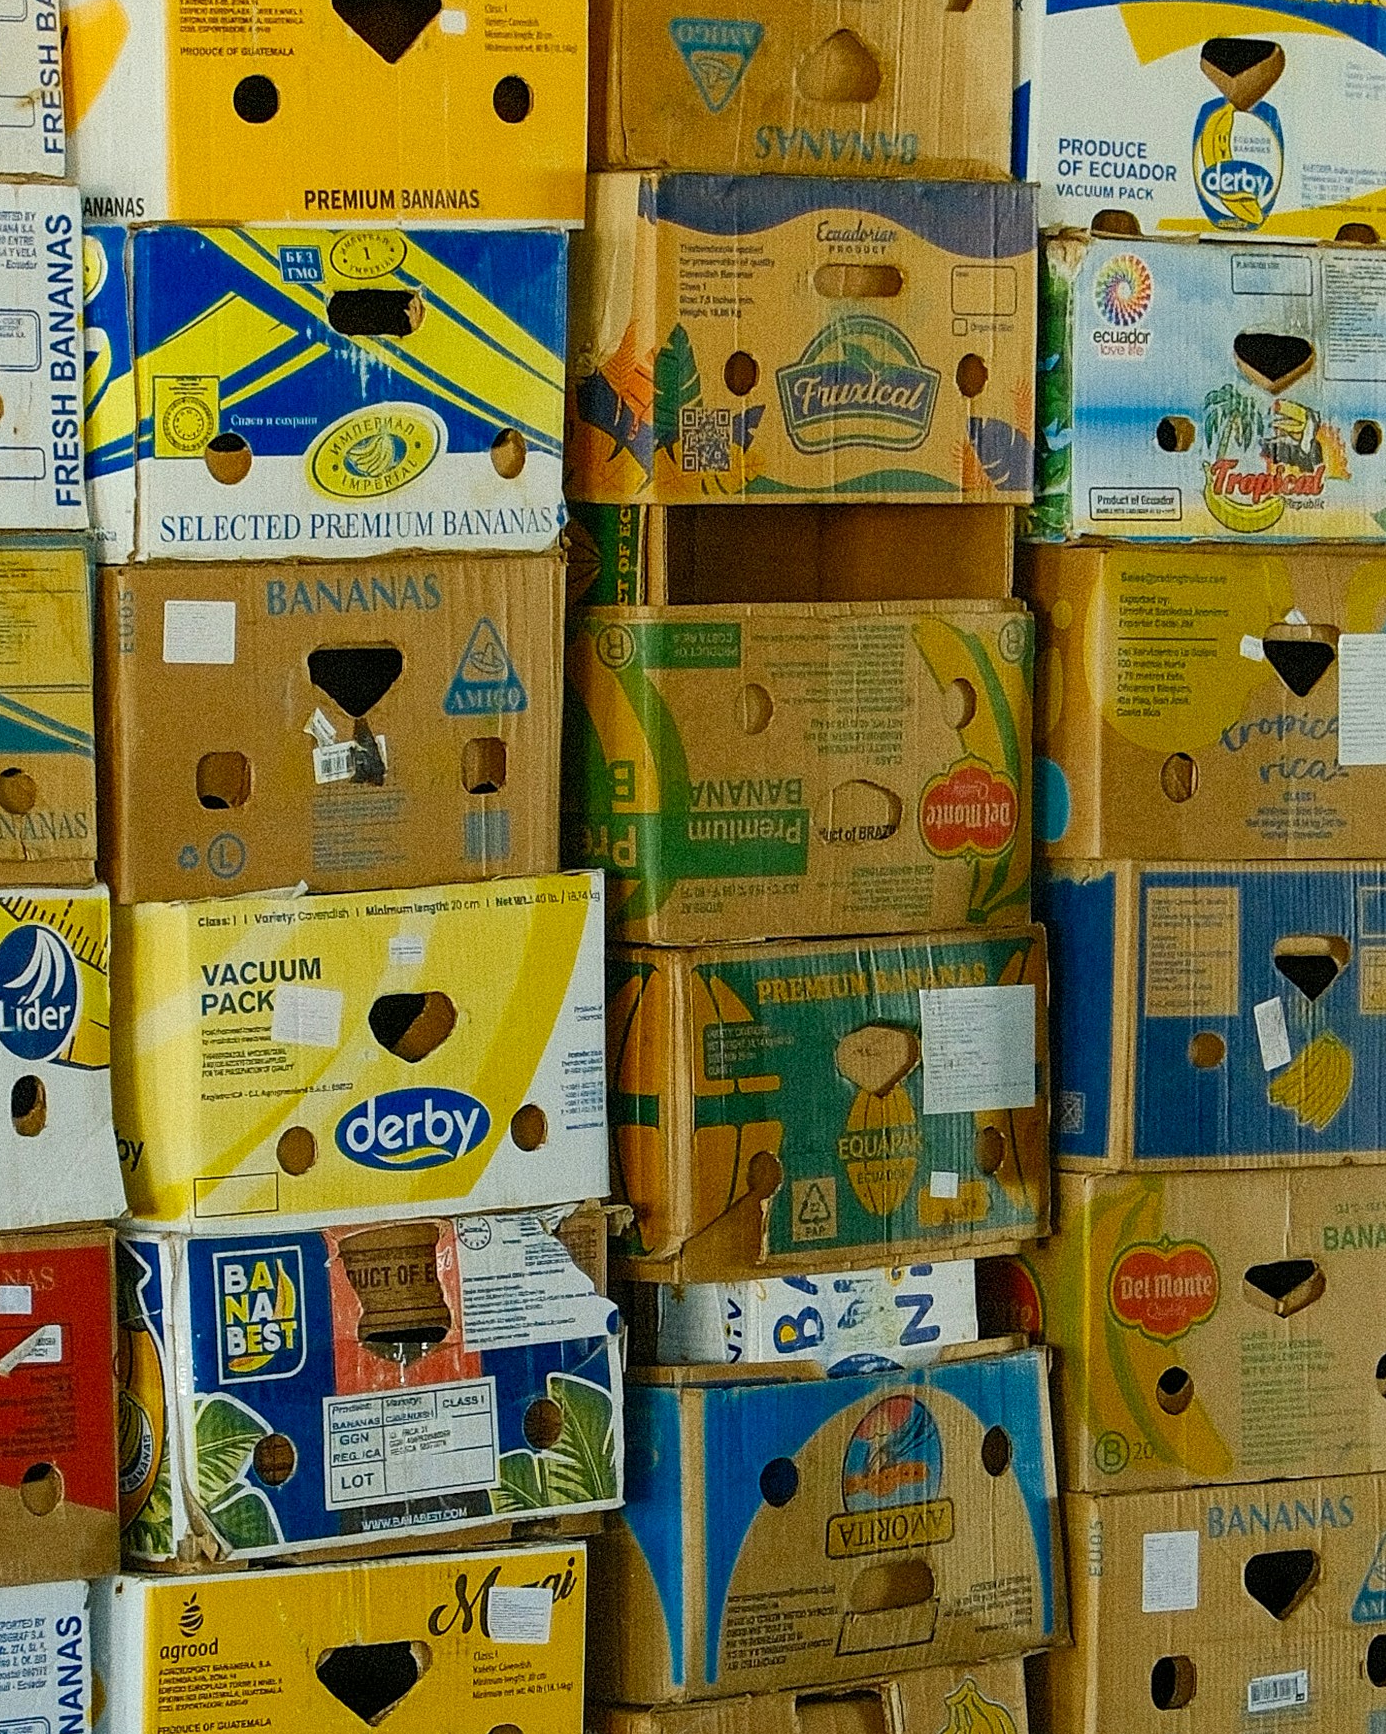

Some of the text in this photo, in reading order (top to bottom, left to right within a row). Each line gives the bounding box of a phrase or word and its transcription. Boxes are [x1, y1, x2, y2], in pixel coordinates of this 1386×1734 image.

[41, 52, 65, 155] FRESH
[756, 126, 919, 163] BANANAS
[1058, 139, 1147, 160] PRODUCE
[1058, 159, 1177, 182] OF ECUADOR
[1204, 165, 1275, 199] derby
[304, 189, 480, 211] PREMIUM BANANAS
[1057, 184, 1154, 201] VACUUM PACK
[285, 251, 315, 264] БЕЗ
[829, 244, 888, 256] PRODUCT
[286, 266, 319, 280] ГМО
[1093, 329, 1151, 347] ecuador
[45, 214, 82, 507] FRESH BANANAS
[794, 377, 925, 418] Fruxical
[1211, 460, 1326, 498] Tropical
[160, 507, 553, 543] SELECTED PREMIUM BANANAS
[265, 574, 443, 616] BANANAS
[687, 815, 803, 844] Premium
[254, 907, 349, 926] Variety: Cavendish
[201, 958, 323, 987] VACUUM
[200, 992, 275, 1017] PACK
[347, 1097, 481, 1154] derby
[227, 1321, 298, 1357] BEST
[339, 1431, 369, 1446] GGN
[339, 1472, 374, 1492] LOT
[1208, 1497, 1355, 1539] BANANAS
[158, 1638, 219, 1661] agrood
